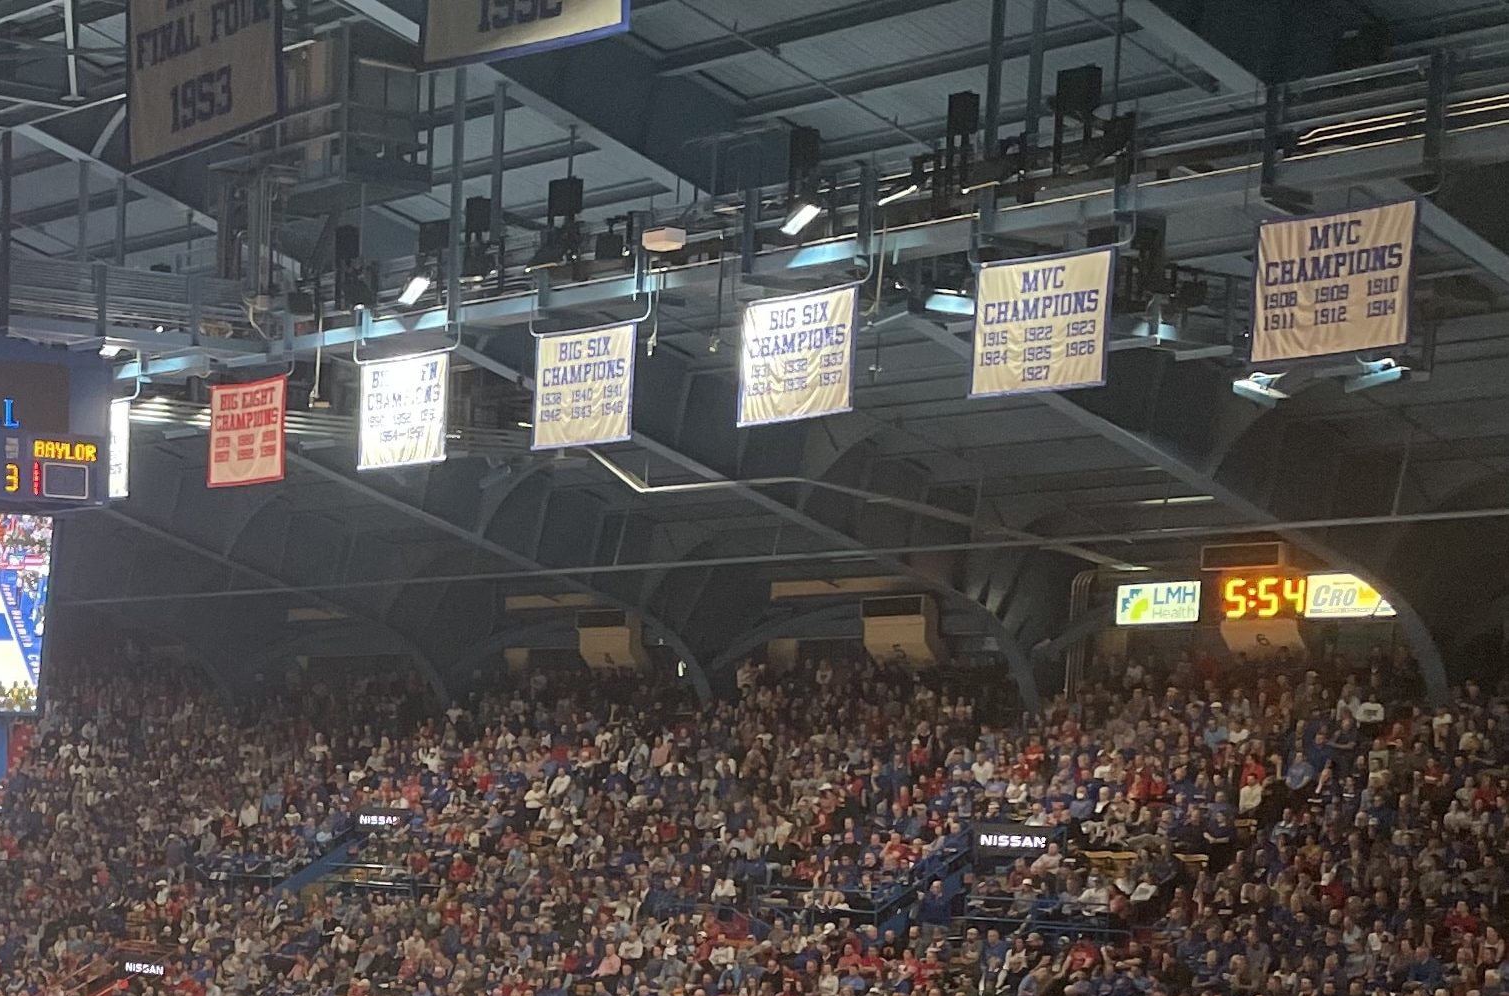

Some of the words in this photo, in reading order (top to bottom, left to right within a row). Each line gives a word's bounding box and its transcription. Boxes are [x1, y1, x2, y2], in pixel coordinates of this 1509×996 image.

[170, 64, 233, 133] 1953
[1309, 219, 1362, 251] MVC
[1265, 242, 1402, 287] CHAMPIONS
[1020, 265, 1066, 294] MVC
[1314, 284, 1349, 304] 1909
[1366, 276, 1399, 296] 1910
[769, 307, 796, 331] BIG
[802, 300, 828, 326] SIX
[984, 289, 1099, 326] CHAMPIONS
[1263, 313, 1294, 331] 1911
[1313, 306, 1347, 326] 1912
[1366, 298, 1396, 318] 1914
[750, 323, 846, 359] CHAMPIONS
[983, 330, 1008, 347] 1915
[1023, 325, 1053, 343] 1922
[1066, 319, 1096, 337] 1923
[558, 340, 582, 362] BIG
[587, 336, 611, 358] SIX
[979, 350, 1008, 367] 1924
[1022, 345, 1052, 362] 1925
[1065, 340, 1095, 357] 1926
[542, 358, 626, 387] CHAMPIONS
[1021, 365, 1050, 382] 1927
[220, 393, 238, 411] BIG
[215, 407, 279, 432] CHAMPIONS
[33, 440, 97, 462] BAYLOR
[5, 463, 20, 492] 3
[1153, 585, 1196, 605] LMH
[1224, 577, 1306, 618] 5:54
[1152, 606, 1196, 620] Health
[980, 833, 1047, 849] NISSAN
[124, 962, 165, 976] NISSAN
